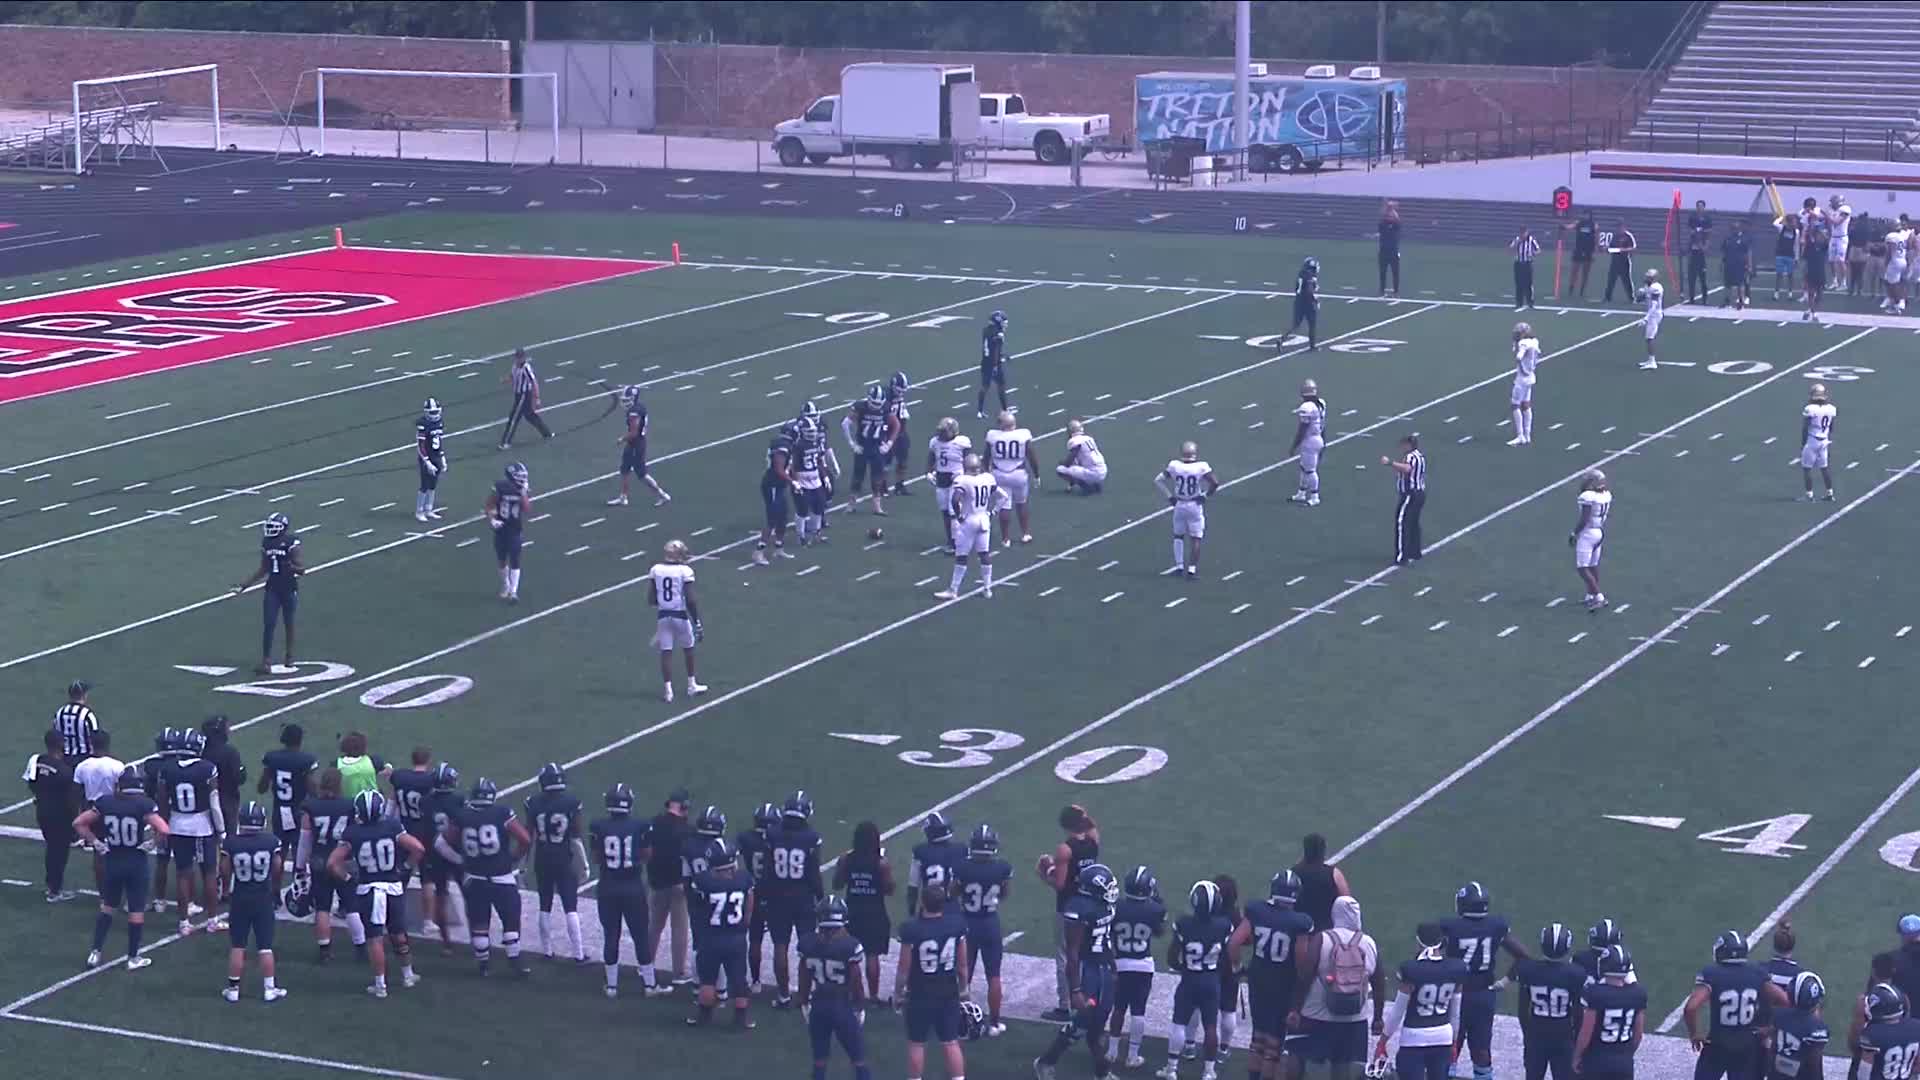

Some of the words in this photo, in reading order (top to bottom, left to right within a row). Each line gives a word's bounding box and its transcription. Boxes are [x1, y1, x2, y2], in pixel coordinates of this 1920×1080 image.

[1556, 192, 1569, 209] 3
[1234, 217, 1246, 231] 10
[1600, 232, 1613, 247] 20
[940, 451, 949, 467] 5
[995, 440, 1020, 460] 90
[974, 485, 989, 508] 10
[1176, 475, 1197, 496] 28
[272, 555, 280, 573] 1
[663, 577, 673, 601] 8
[62, 714, 77, 736] H
[176, 783, 195, 812] 0
[276, 769, 293, 801] 5
[398, 789, 422, 819] 19
[103, 815, 138, 847] 30
[314, 815, 348, 845] 74
[462, 824, 500, 857] 69
[536, 813, 569, 843] 13
[233, 850, 271, 883] 89
[358, 838, 395, 872] 40
[604, 835, 633, 869] 91
[709, 891, 745, 926] 73
[964, 882, 1000, 912] 34
[919, 937, 956, 973] 64
[1185, 941, 1222, 971] 24
[1254, 927, 1290, 963] 70
[1458, 936, 1493, 972] 71
[1416, 982, 1457, 1017] 99
[1529, 985, 1570, 1018] 50
[1719, 988, 1758, 1026] 26
